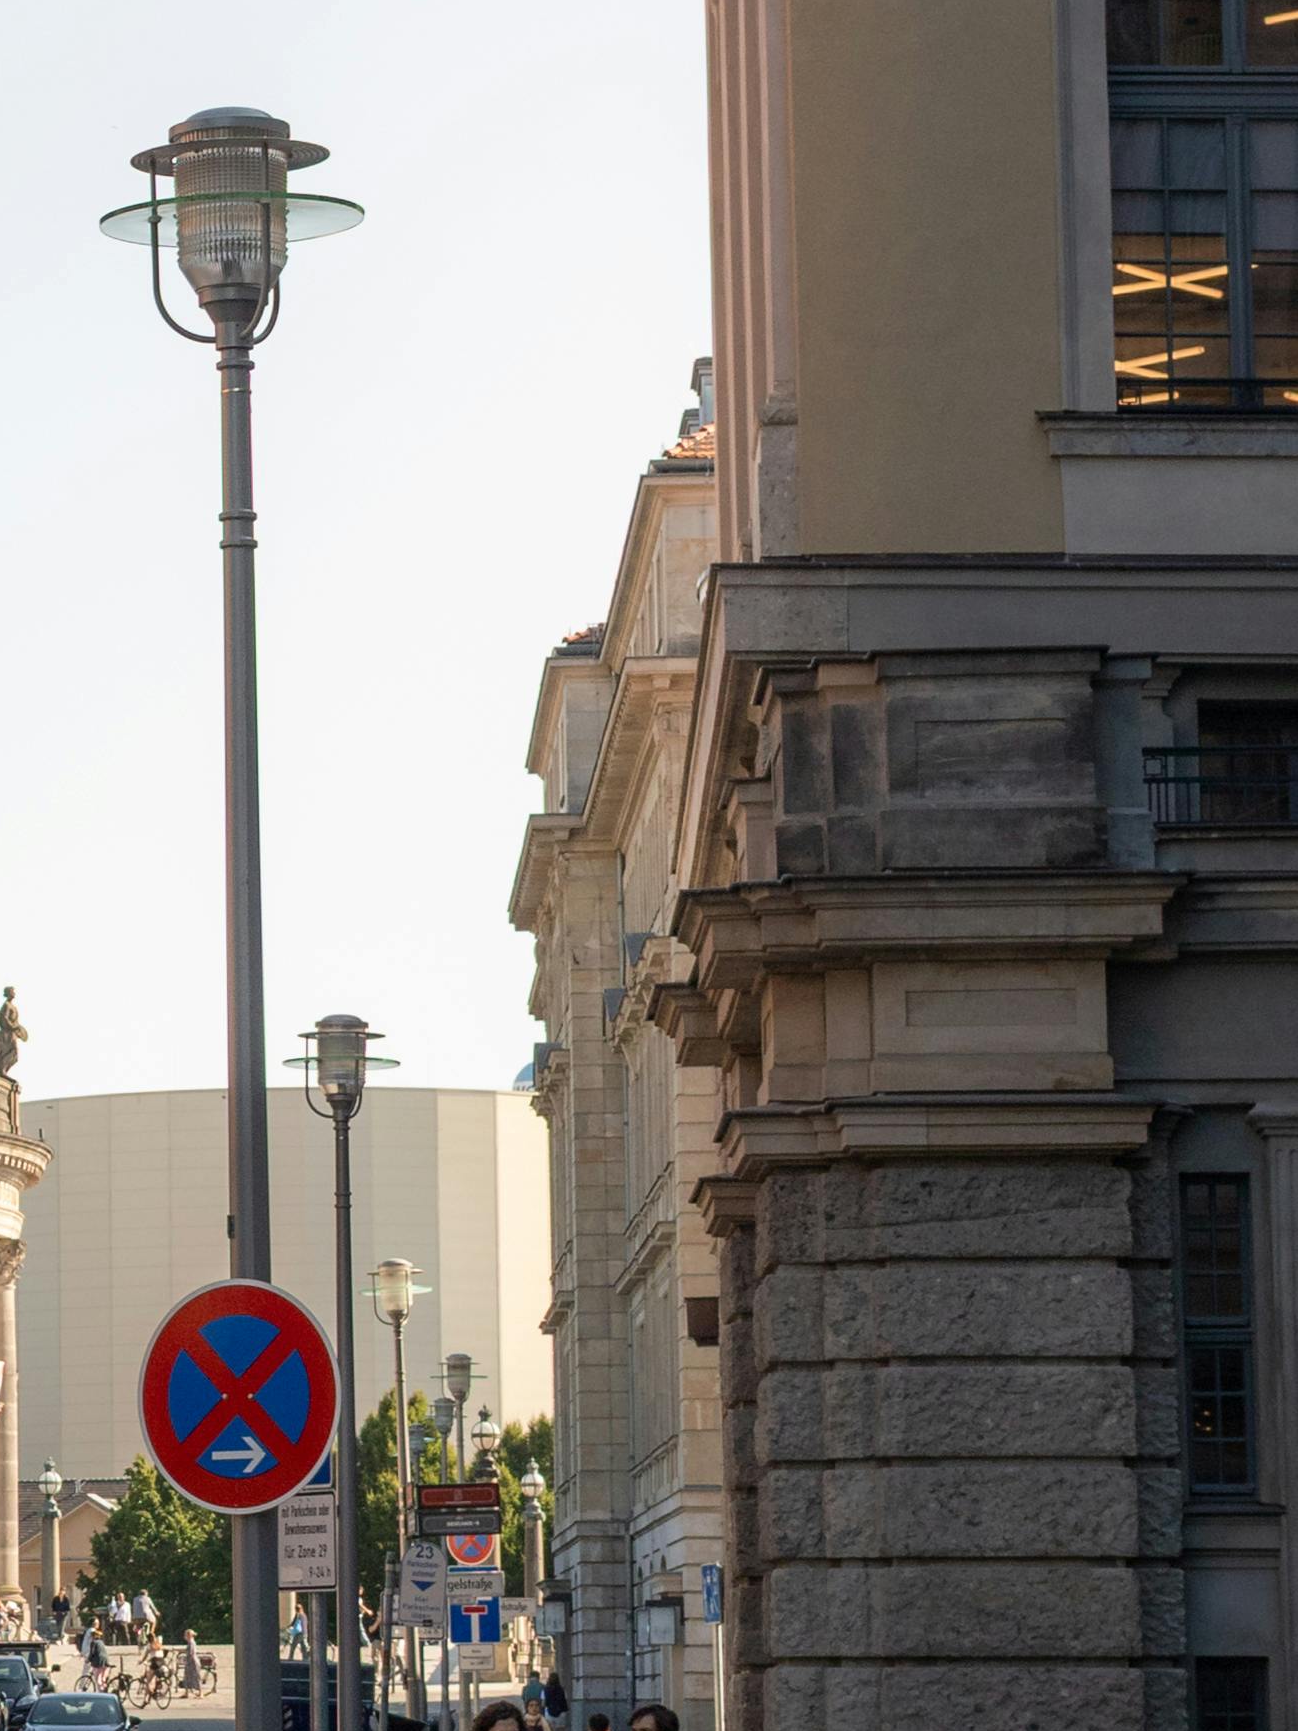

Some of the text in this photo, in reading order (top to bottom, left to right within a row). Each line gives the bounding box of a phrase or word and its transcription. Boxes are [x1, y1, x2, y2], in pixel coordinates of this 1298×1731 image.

[297, 1544, 317, 1559] Zone
[415, 1544, 434, 1559] 23
[447, 1577, 493, 1593] gelstraße
